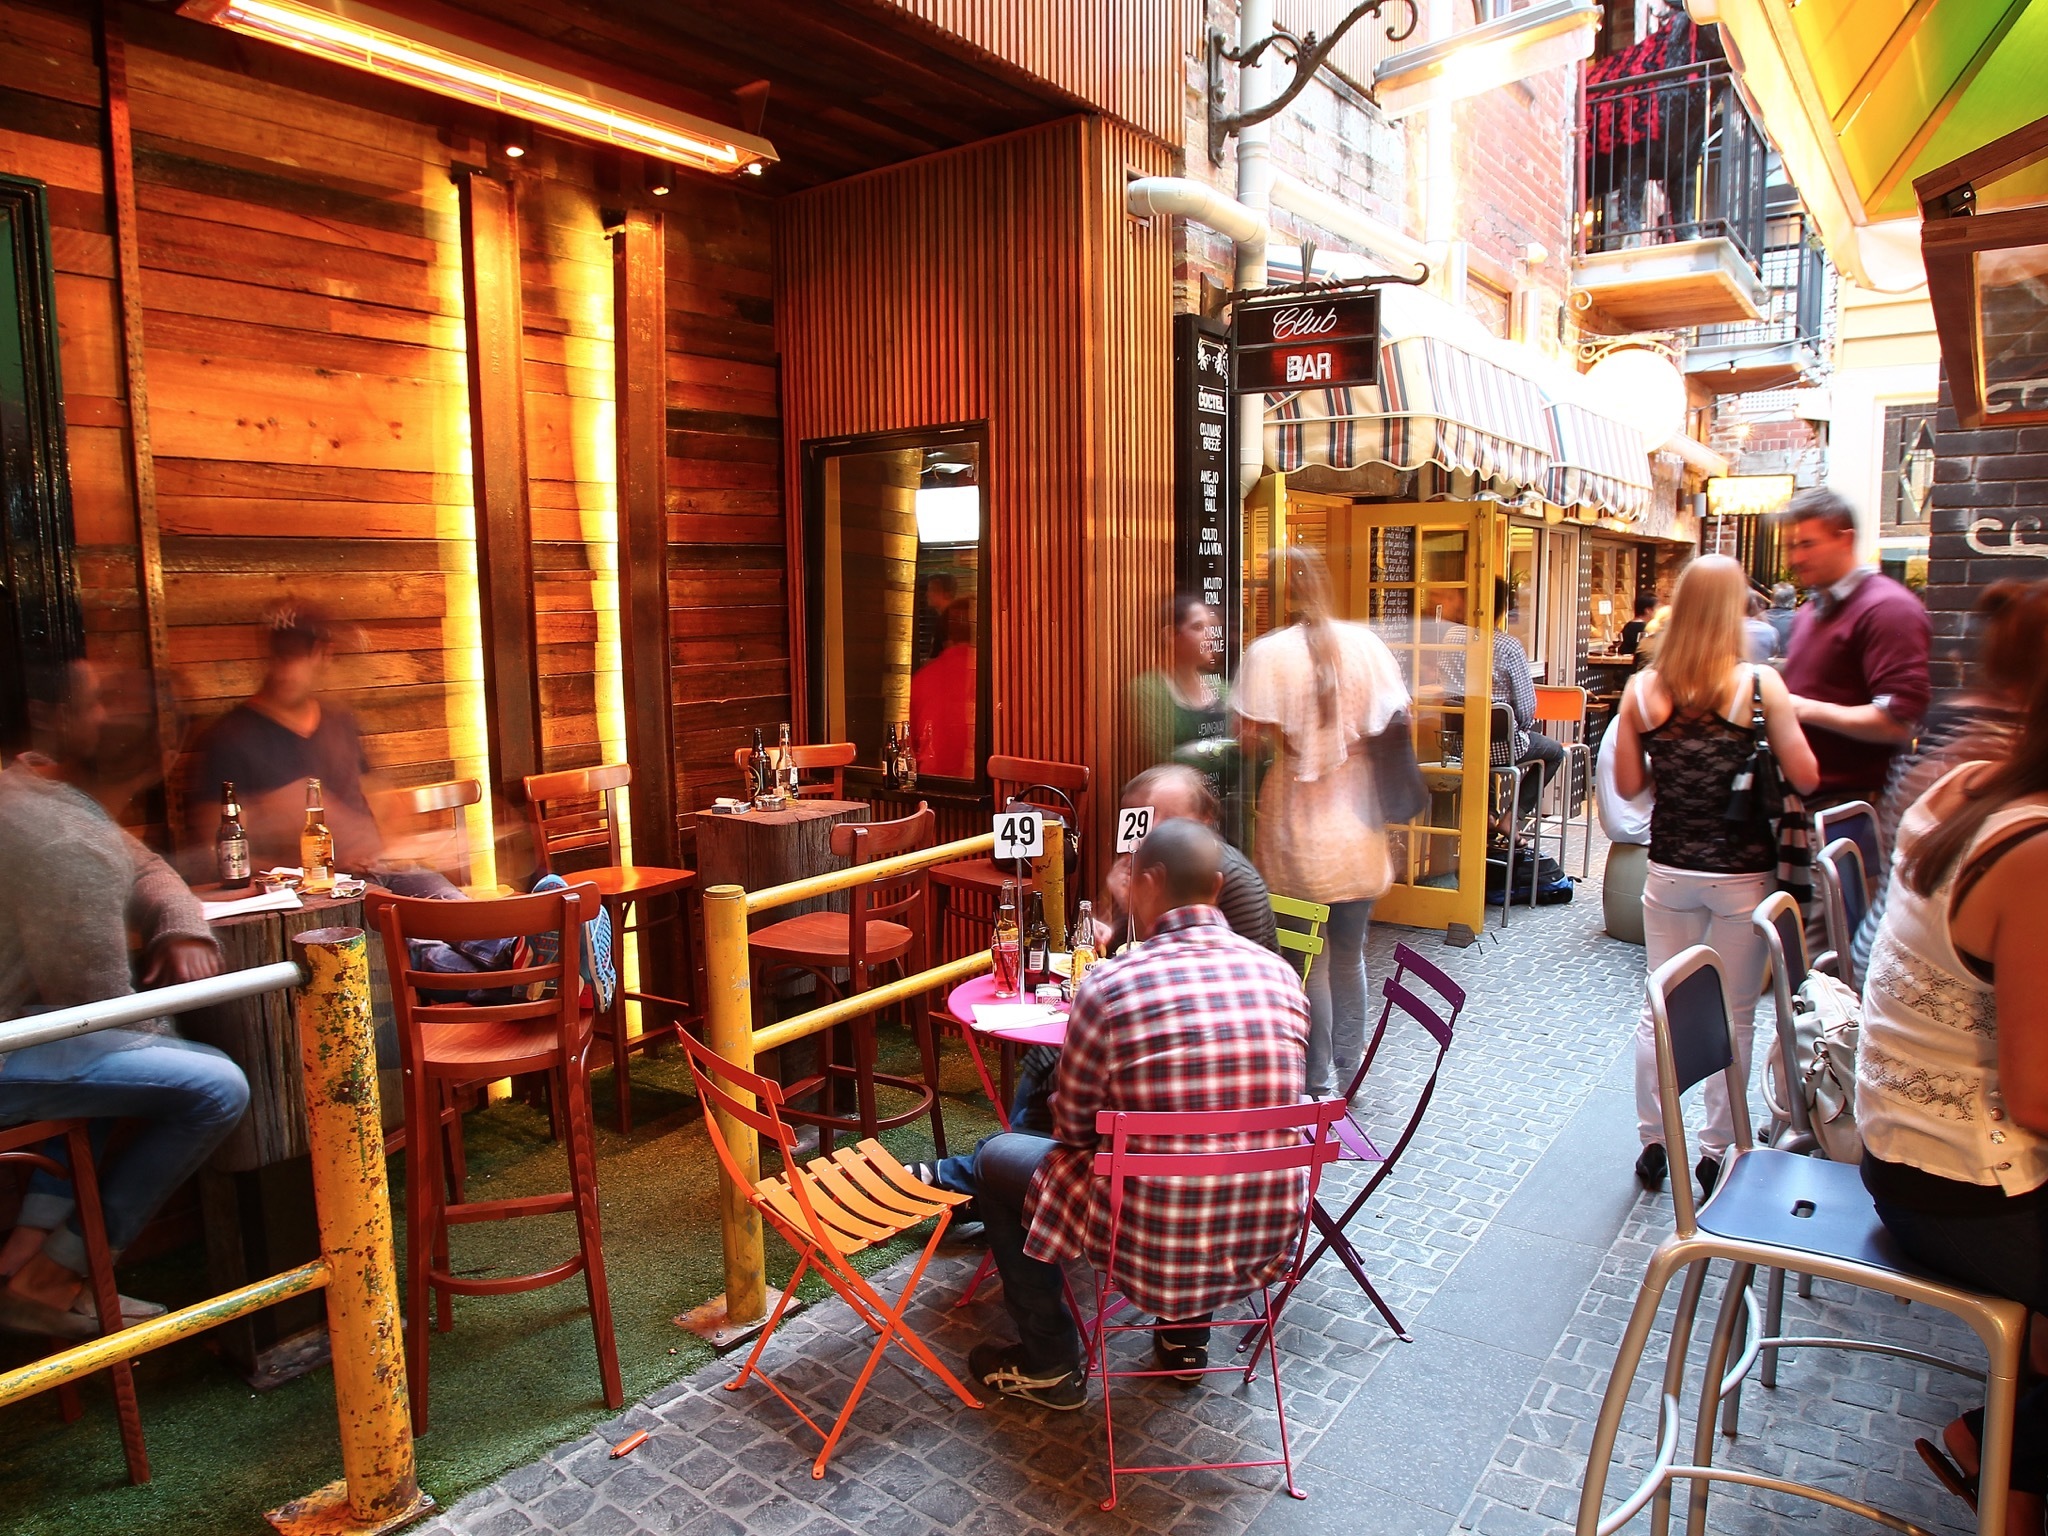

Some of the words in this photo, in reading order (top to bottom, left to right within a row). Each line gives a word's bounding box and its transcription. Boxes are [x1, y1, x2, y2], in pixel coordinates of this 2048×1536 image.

[1273, 307, 1337, 340] Club
[1287, 352, 1332, 383] BAR
[1198, 391, 1225, 411] COCTEL
[1203, 436, 1222, 452] BREEZE
[1203, 577, 1223, 591] MOJITO
[1205, 591, 1220, 605] ROYAL
[1204, 625, 1223, 640] CUBAN
[1001, 816, 1035, 847] 49
[1123, 810, 1149, 840] 29
